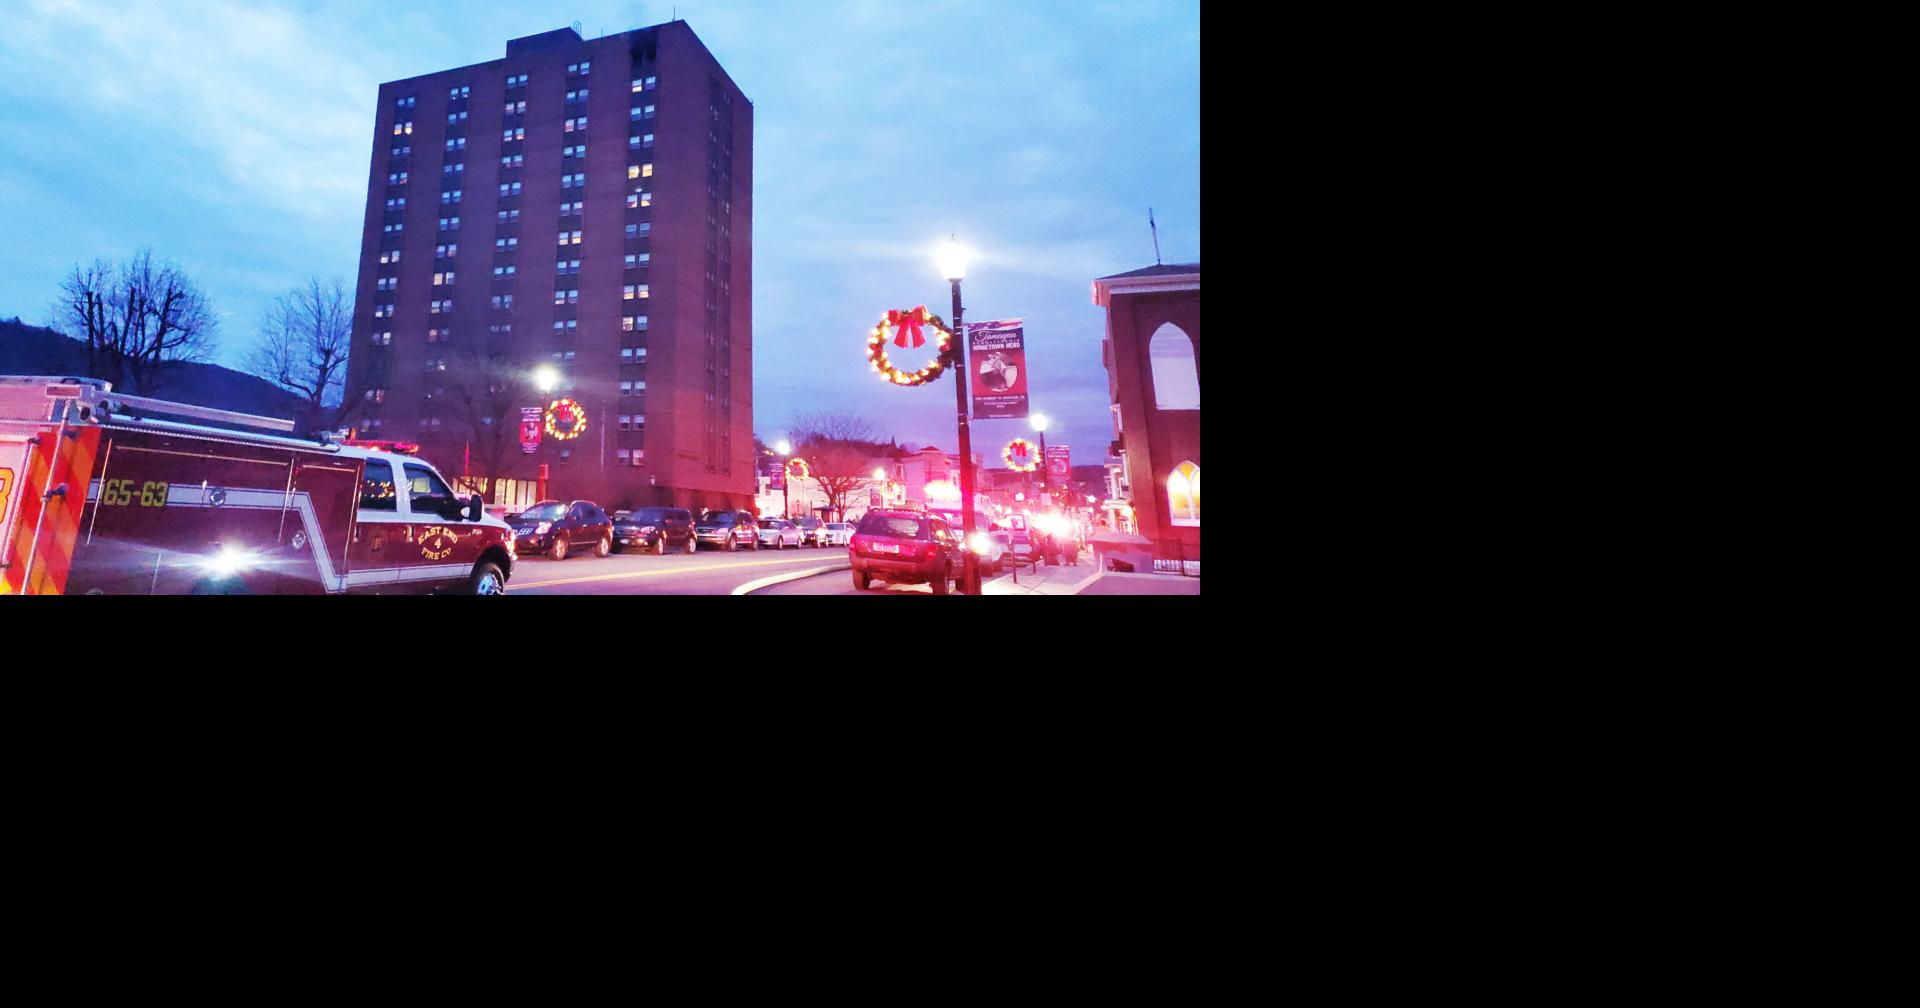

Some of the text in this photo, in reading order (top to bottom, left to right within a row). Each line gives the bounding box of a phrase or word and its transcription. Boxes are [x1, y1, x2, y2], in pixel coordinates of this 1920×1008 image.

[103, 479, 168, 507] 65-63
[418, 526, 458, 545] EAST END
[434, 538, 441, 549] 4
[421, 547, 440, 560] FIRE
